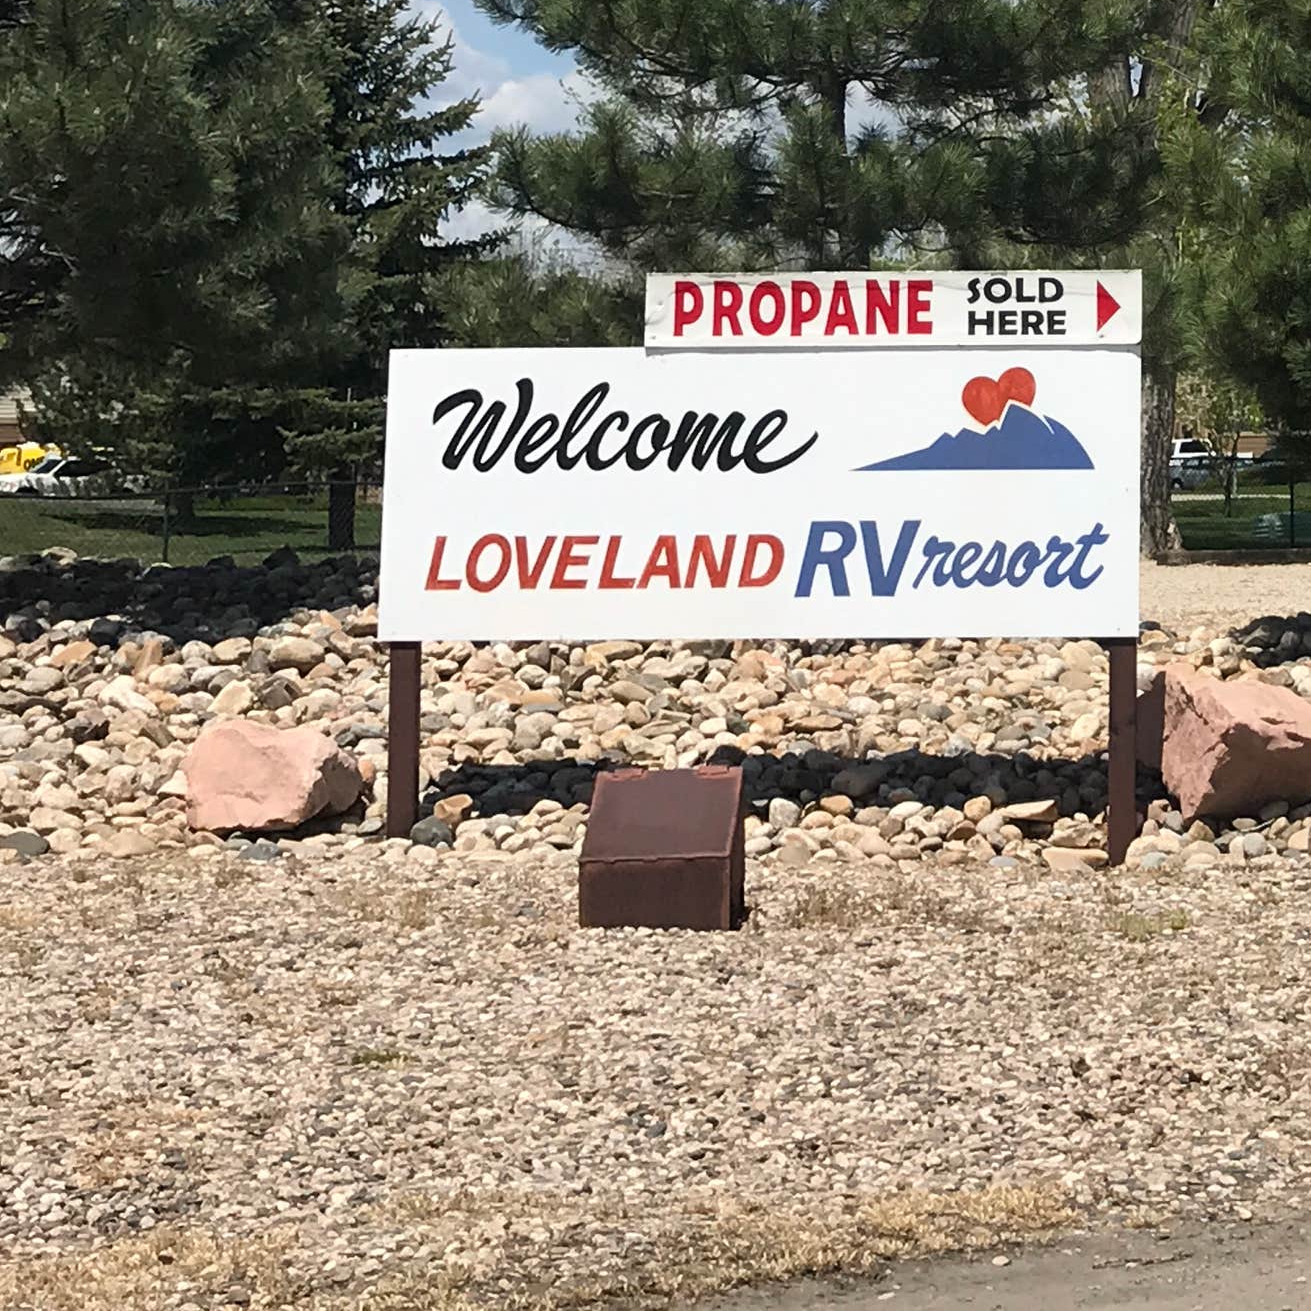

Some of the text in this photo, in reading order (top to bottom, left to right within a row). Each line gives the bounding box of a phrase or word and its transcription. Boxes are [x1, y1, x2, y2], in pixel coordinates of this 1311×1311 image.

[672, 279, 934, 338] PROPANE
[966, 277, 1064, 304] SOLD
[966, 310, 1067, 336] HERE
[432, 377, 819, 475] Welcome
[425, 520, 1110, 598] LOVELAND RV resort
